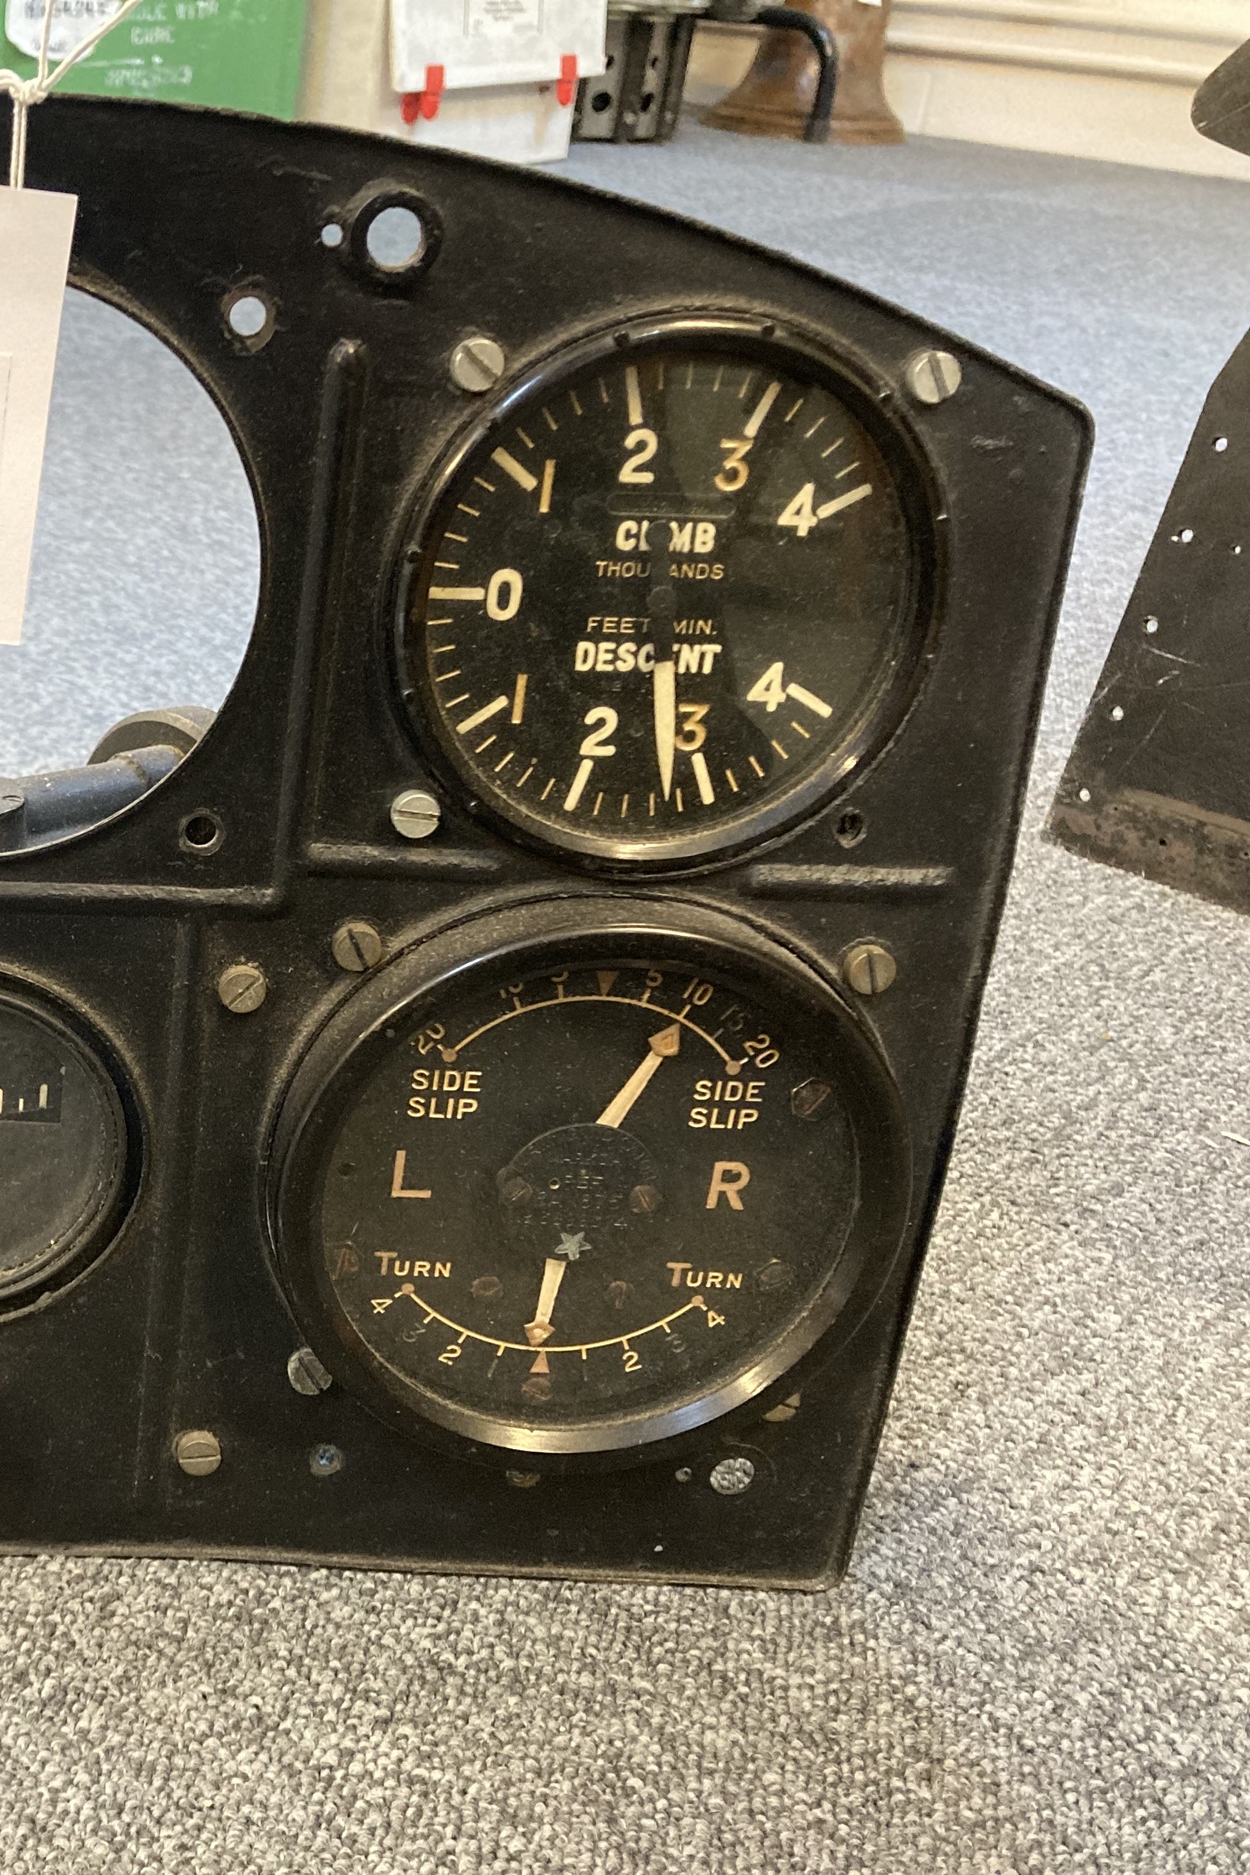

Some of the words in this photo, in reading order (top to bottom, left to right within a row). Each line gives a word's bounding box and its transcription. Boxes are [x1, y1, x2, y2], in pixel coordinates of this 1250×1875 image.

[618, 428, 659, 484] 2
[713, 439, 754, 491] 3
[777, 482, 818, 537] 4
[615, 519, 717, 554] CLMB
[595, 560, 725, 580] THOUANDS
[485, 568, 524, 622] 0
[586, 616, 651, 634] FEET
[747, 661, 788, 712] 4
[578, 706, 619, 757] 2
[675, 703, 710, 751] 3
[682, 977, 714, 1006] 10
[742, 1034, 780, 1069] 20
[410, 1070, 482, 1093] SIDE
[693, 1080, 766, 1103] SIDE
[406, 1097, 479, 1120] SLIP
[688, 1108, 759, 1130] SLIP
[391, 1150, 432, 1199] L
[706, 1161, 750, 1211] R
[371, 1297, 393, 1315] 4
[706, 1309, 726, 1328] 4
[437, 1343, 463, 1366] 2
[622, 1349, 644, 1373] 2
